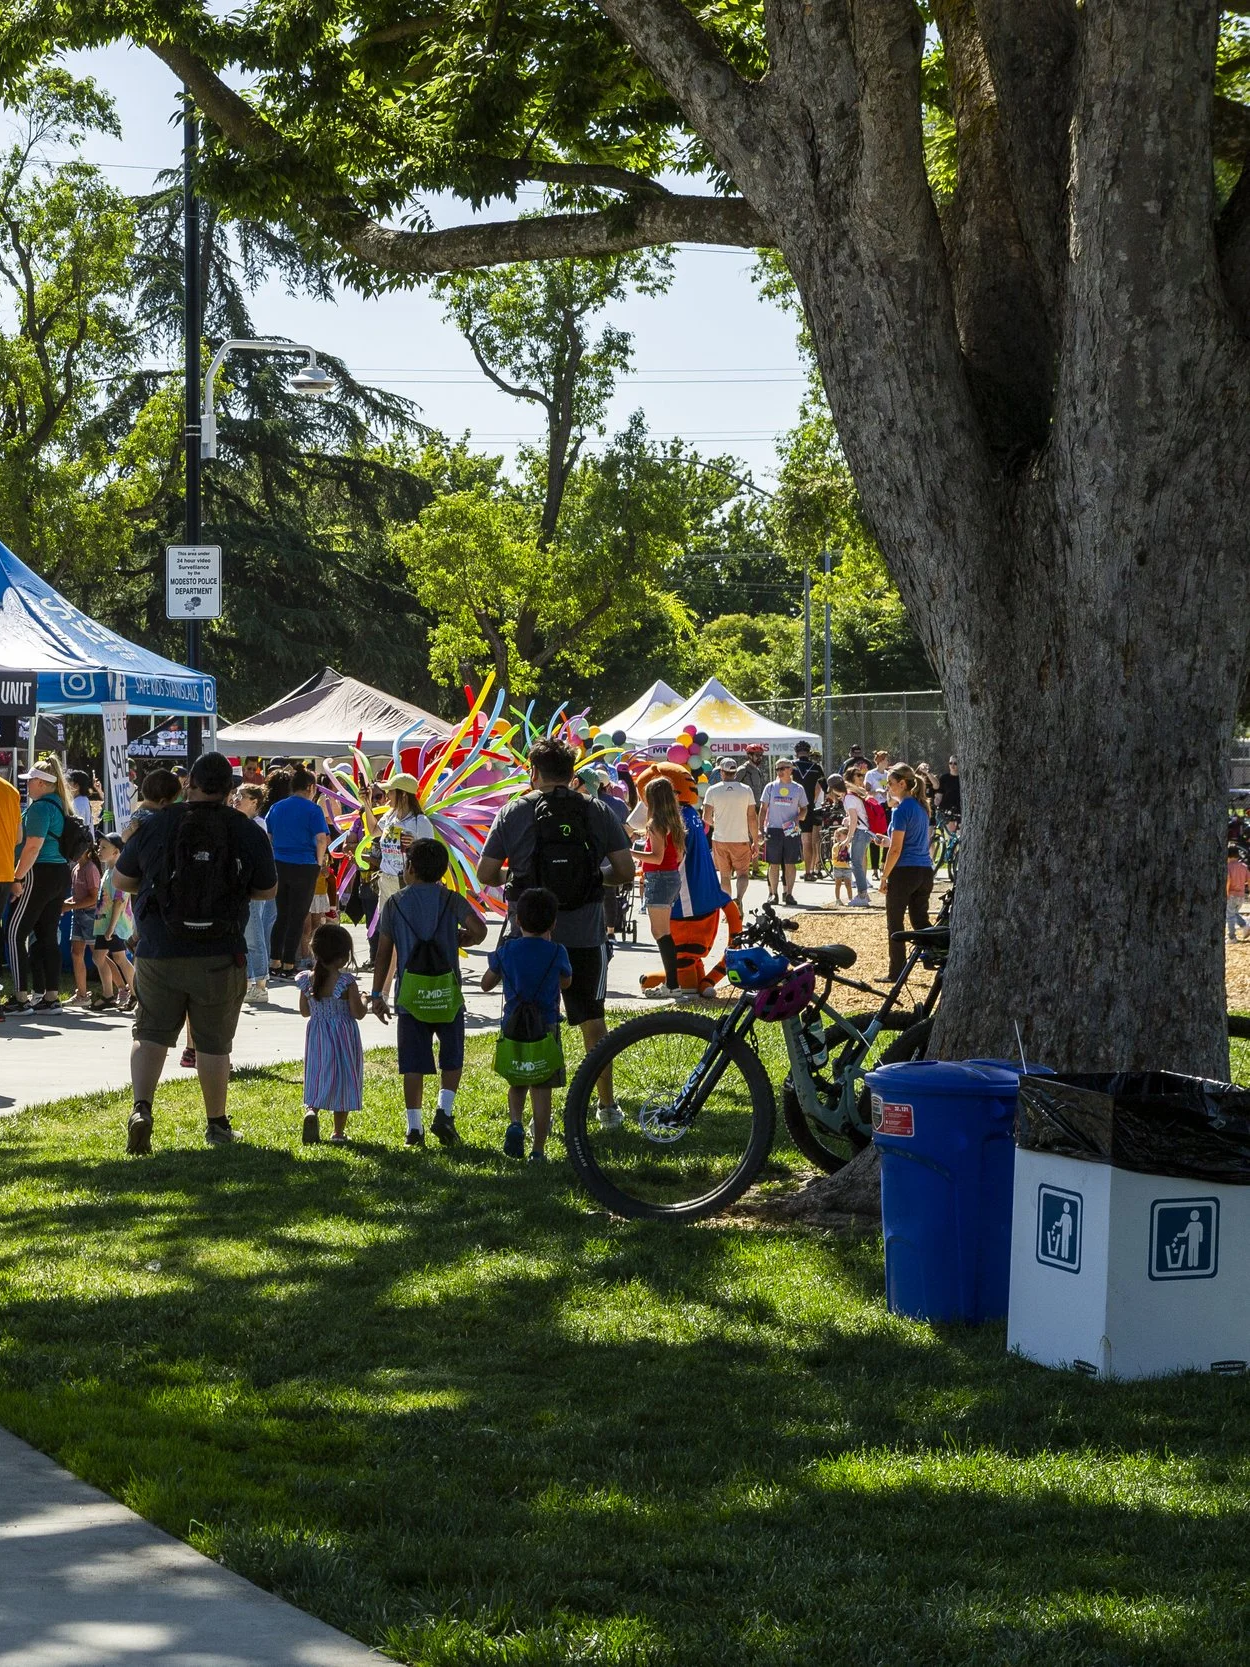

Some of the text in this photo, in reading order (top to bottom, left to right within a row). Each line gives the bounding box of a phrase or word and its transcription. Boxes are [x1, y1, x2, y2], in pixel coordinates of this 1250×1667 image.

[0, 682, 31, 705] UNIT
[135, 678, 199, 701] SAFE KIDS STANISLAUS
[710, 743, 818, 753] CHILDR'S MUSM
